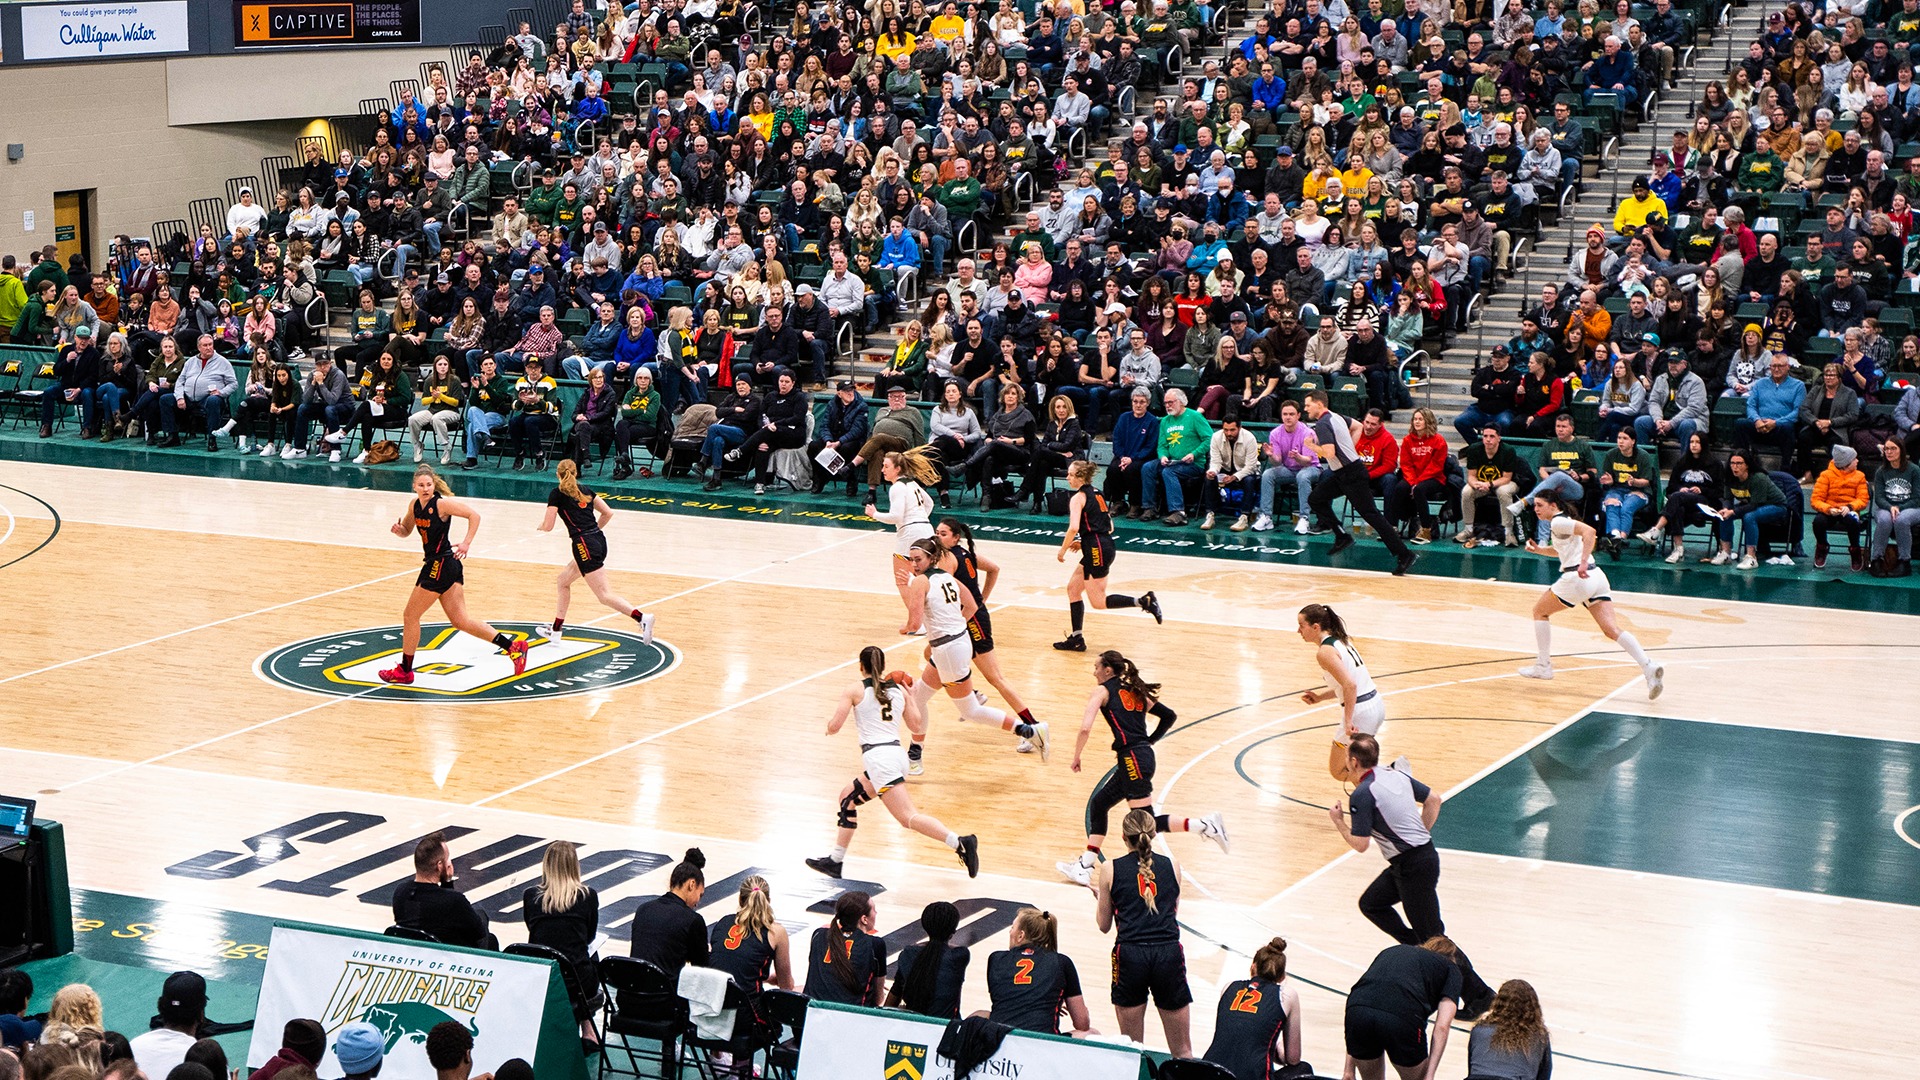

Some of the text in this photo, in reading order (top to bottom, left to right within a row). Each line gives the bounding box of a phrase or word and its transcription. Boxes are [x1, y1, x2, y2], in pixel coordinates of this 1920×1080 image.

[60, 6, 138, 17] You could give your people
[274, 14, 345, 29] CAPTIVE
[60, 22, 157, 52] Culligan Water
[681, 501, 733, 510] Are
[737, 506, 783, 516] We
[1516, 516, 1526, 540] Roots
[1202, 543, 1305, 555] peyak
[941, 582, 957, 604] 15
[299, 640, 366, 668] REGINA
[513, 653, 637, 691] UNIVERSITY
[881, 701, 893, 722] 2
[1124, 756, 1139, 781] CALGARY
[724, 925, 744, 950] 9
[352, 950, 494, 978] UNIVERSITY OF REGINA
[1014, 958, 1035, 984] 2
[319, 960, 490, 1036] COUGARS
[1230, 987, 1263, 1014] 12
[935, 1053, 1024, 1079] Uersity
